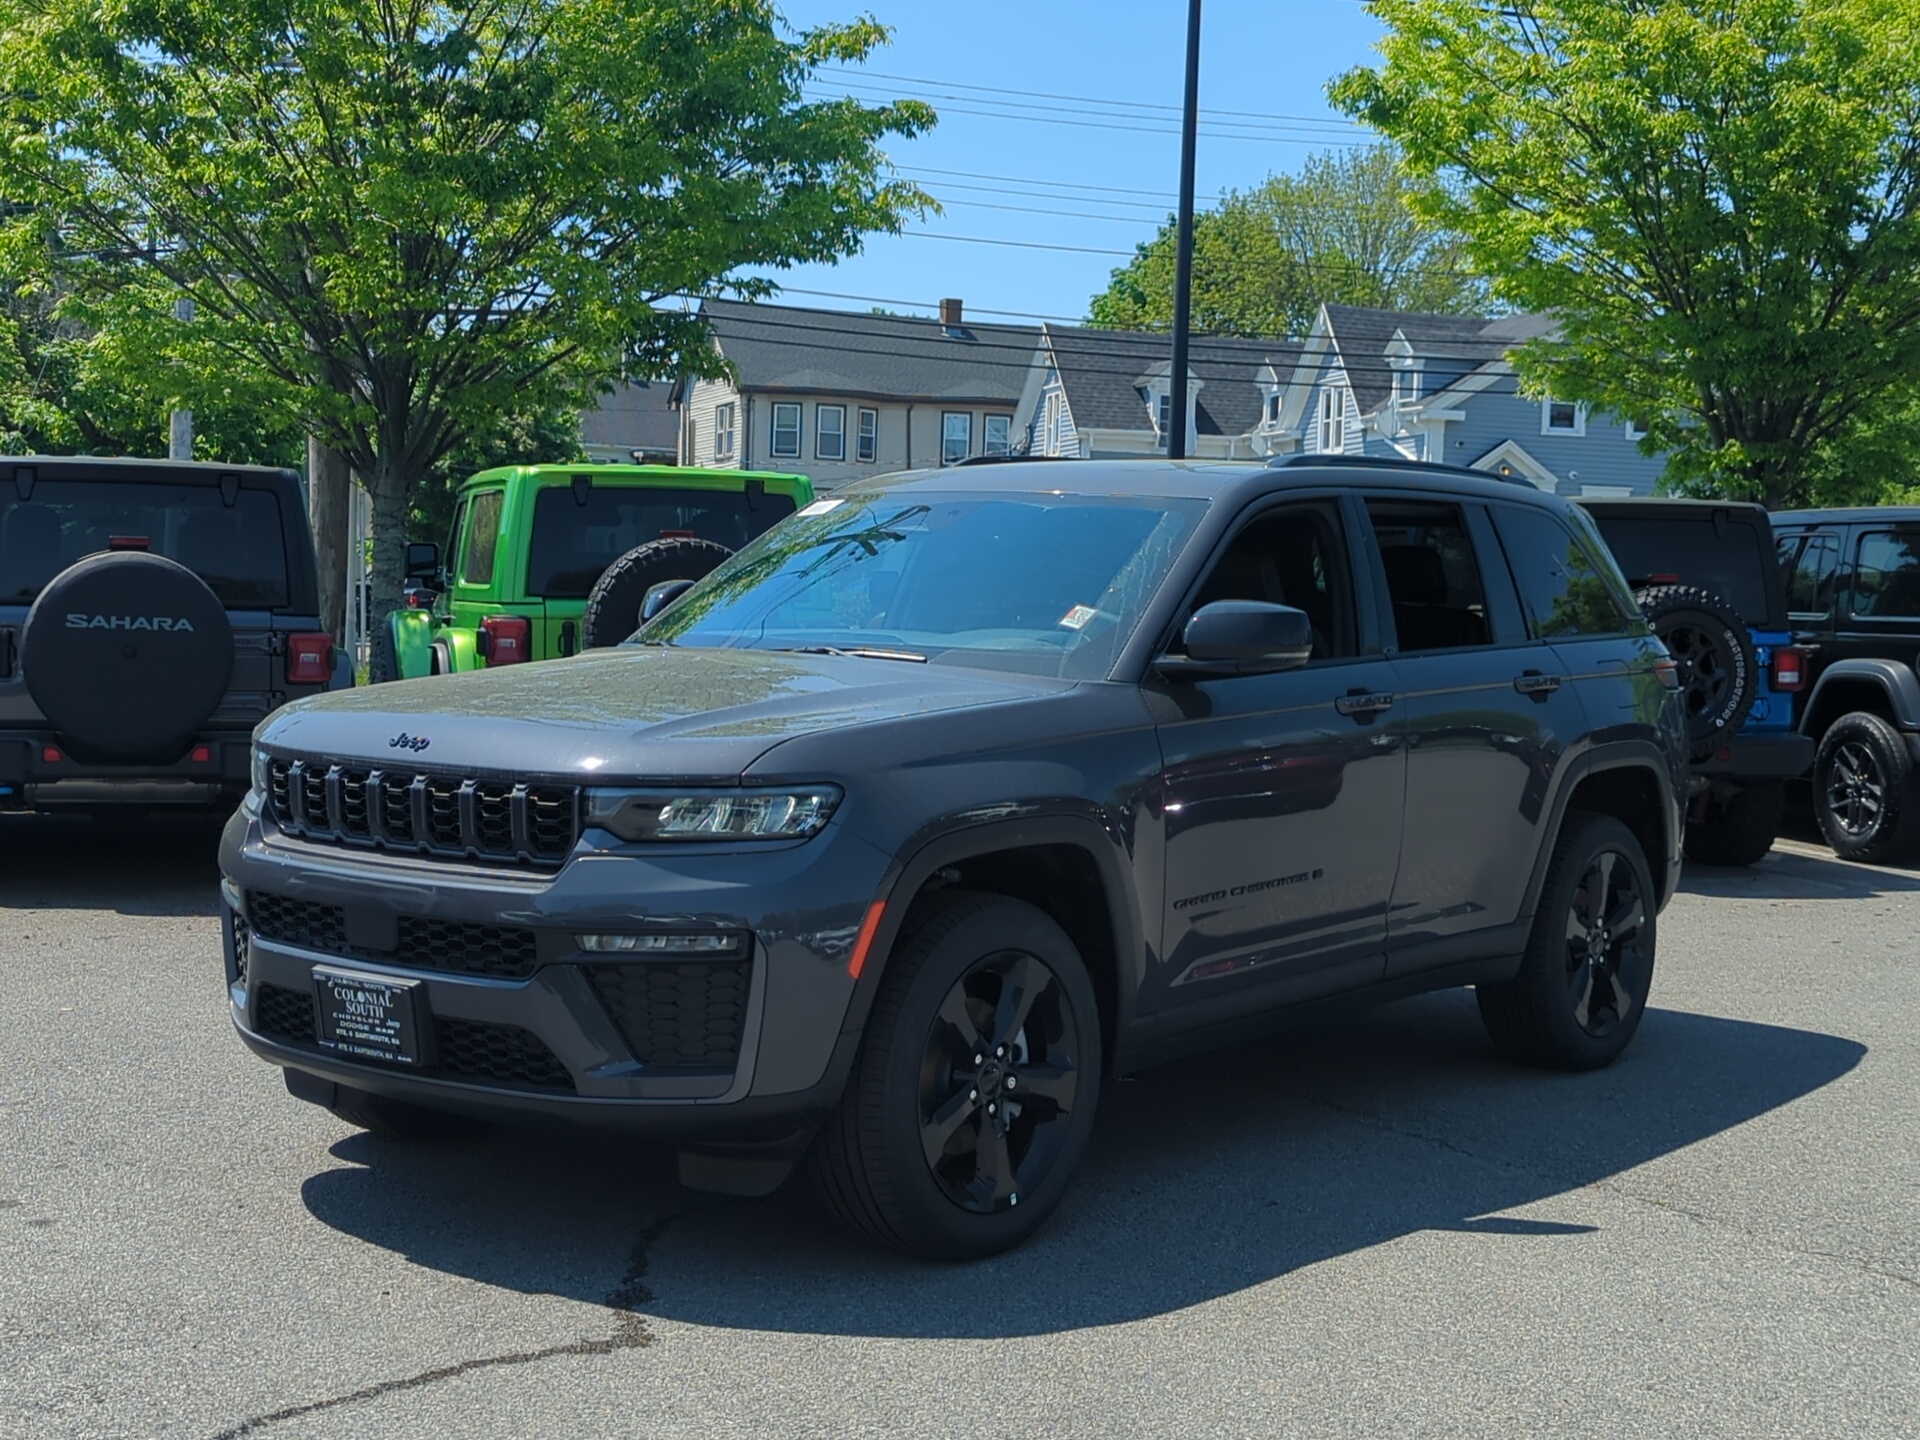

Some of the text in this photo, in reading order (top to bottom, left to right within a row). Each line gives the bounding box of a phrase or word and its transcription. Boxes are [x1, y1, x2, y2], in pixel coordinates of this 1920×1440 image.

[65, 613, 194, 632] SAHARA
[389, 732, 430, 753] Jeep
[334, 987, 393, 1007] COLONIAL
[345, 1001, 384, 1018] SOUTH
[340, 1020, 370, 1031] DODGE
